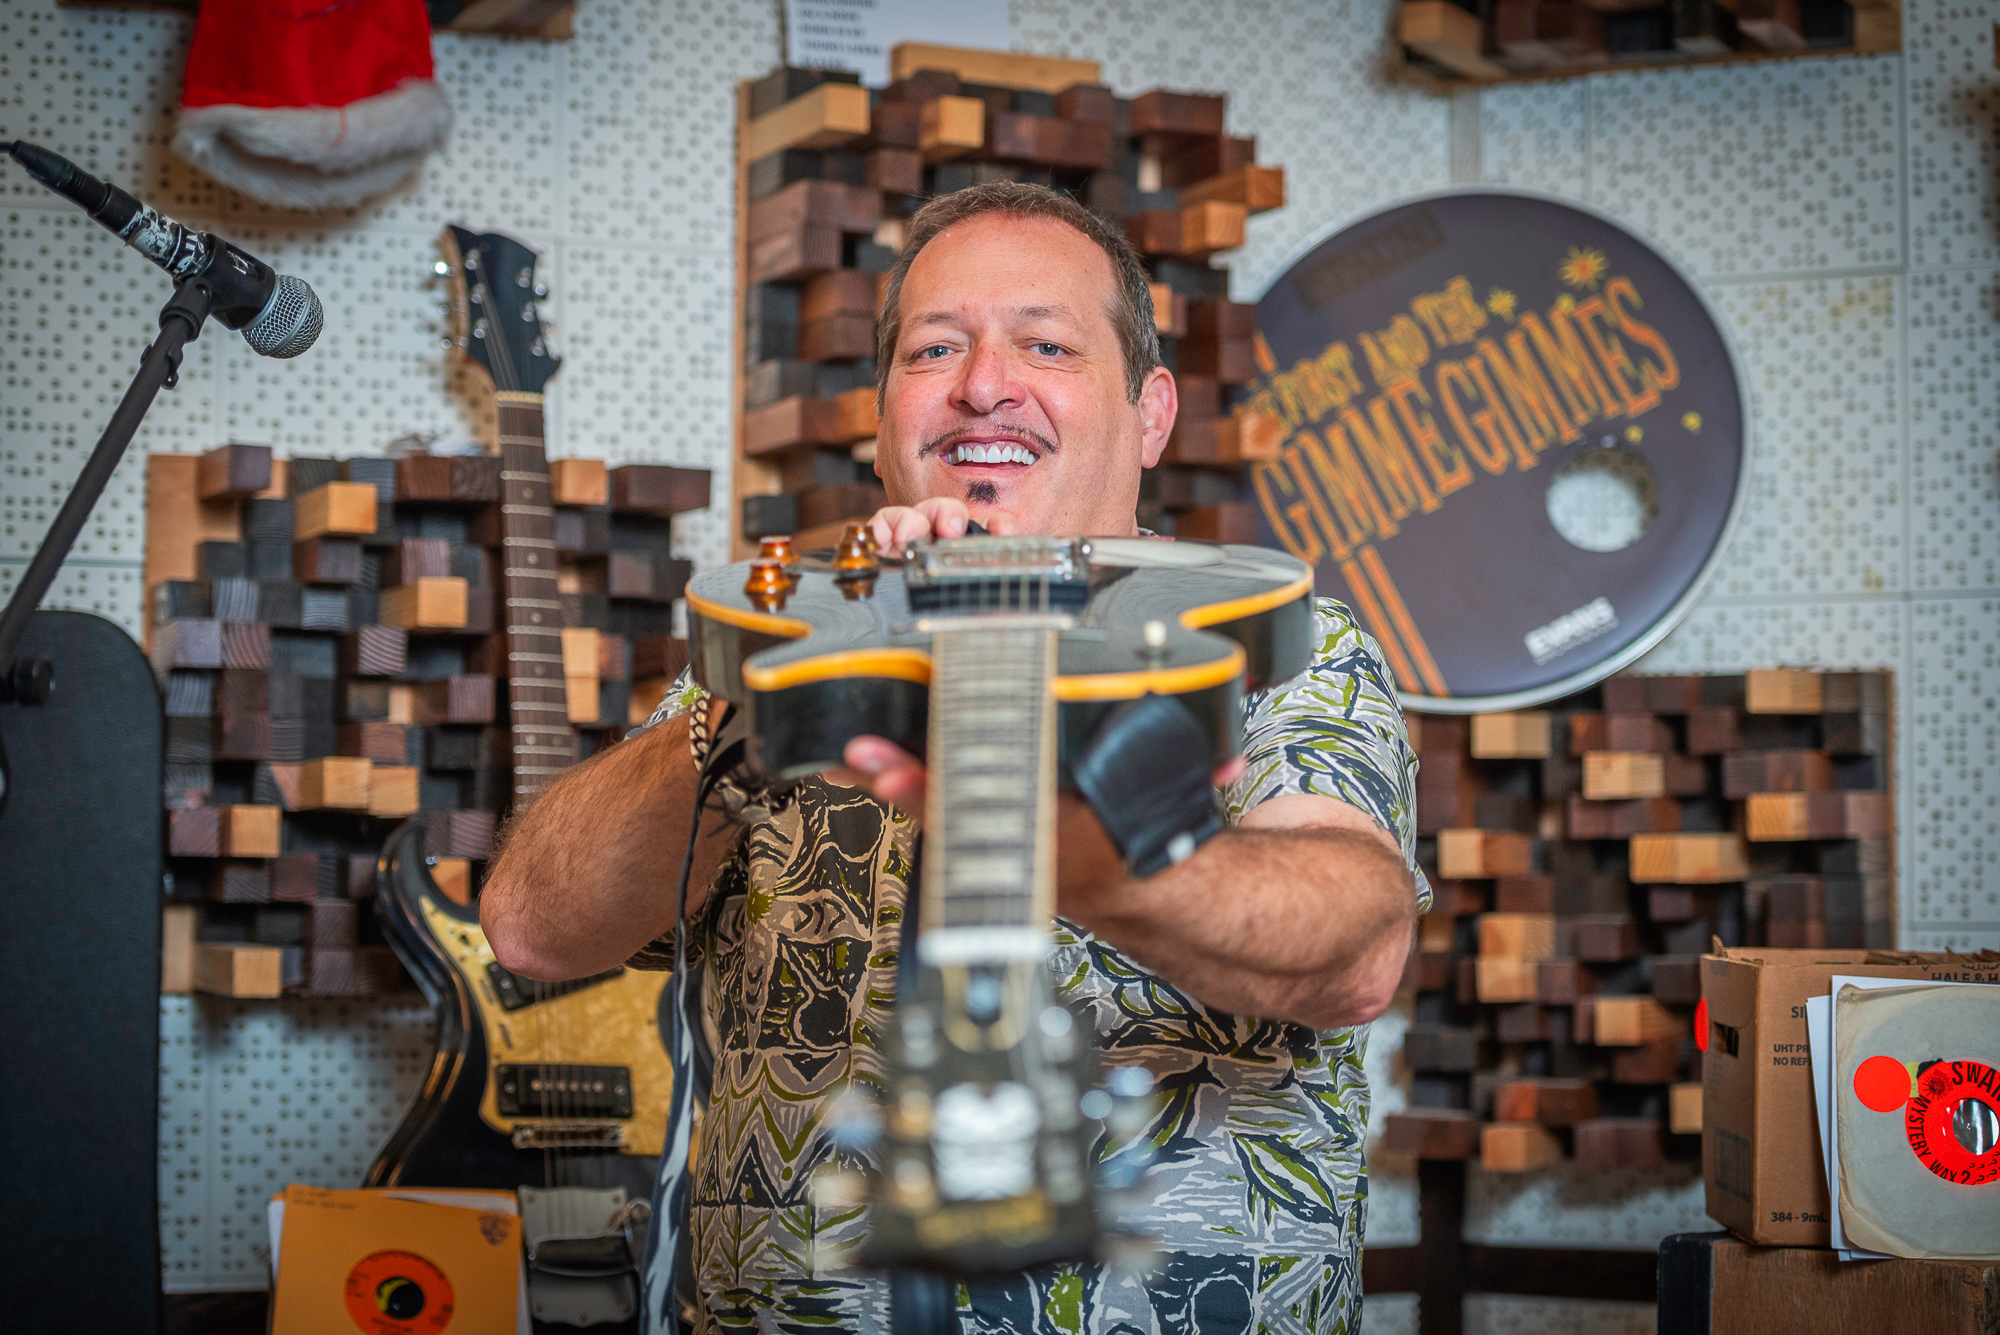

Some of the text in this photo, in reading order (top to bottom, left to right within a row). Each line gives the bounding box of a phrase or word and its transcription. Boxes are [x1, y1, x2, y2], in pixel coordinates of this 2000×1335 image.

[1411, 275, 1488, 347] THE
[1252, 276, 1680, 567] GIMME GIMMES
[1773, 1044, 1795, 1053] UHT
[1773, 1057, 1789, 1066] NO
[1909, 1094, 1931, 1158] MYSTERY
[1771, 1212, 1793, 1222] 384
[1801, 1212, 1827, 1222] 9mL
